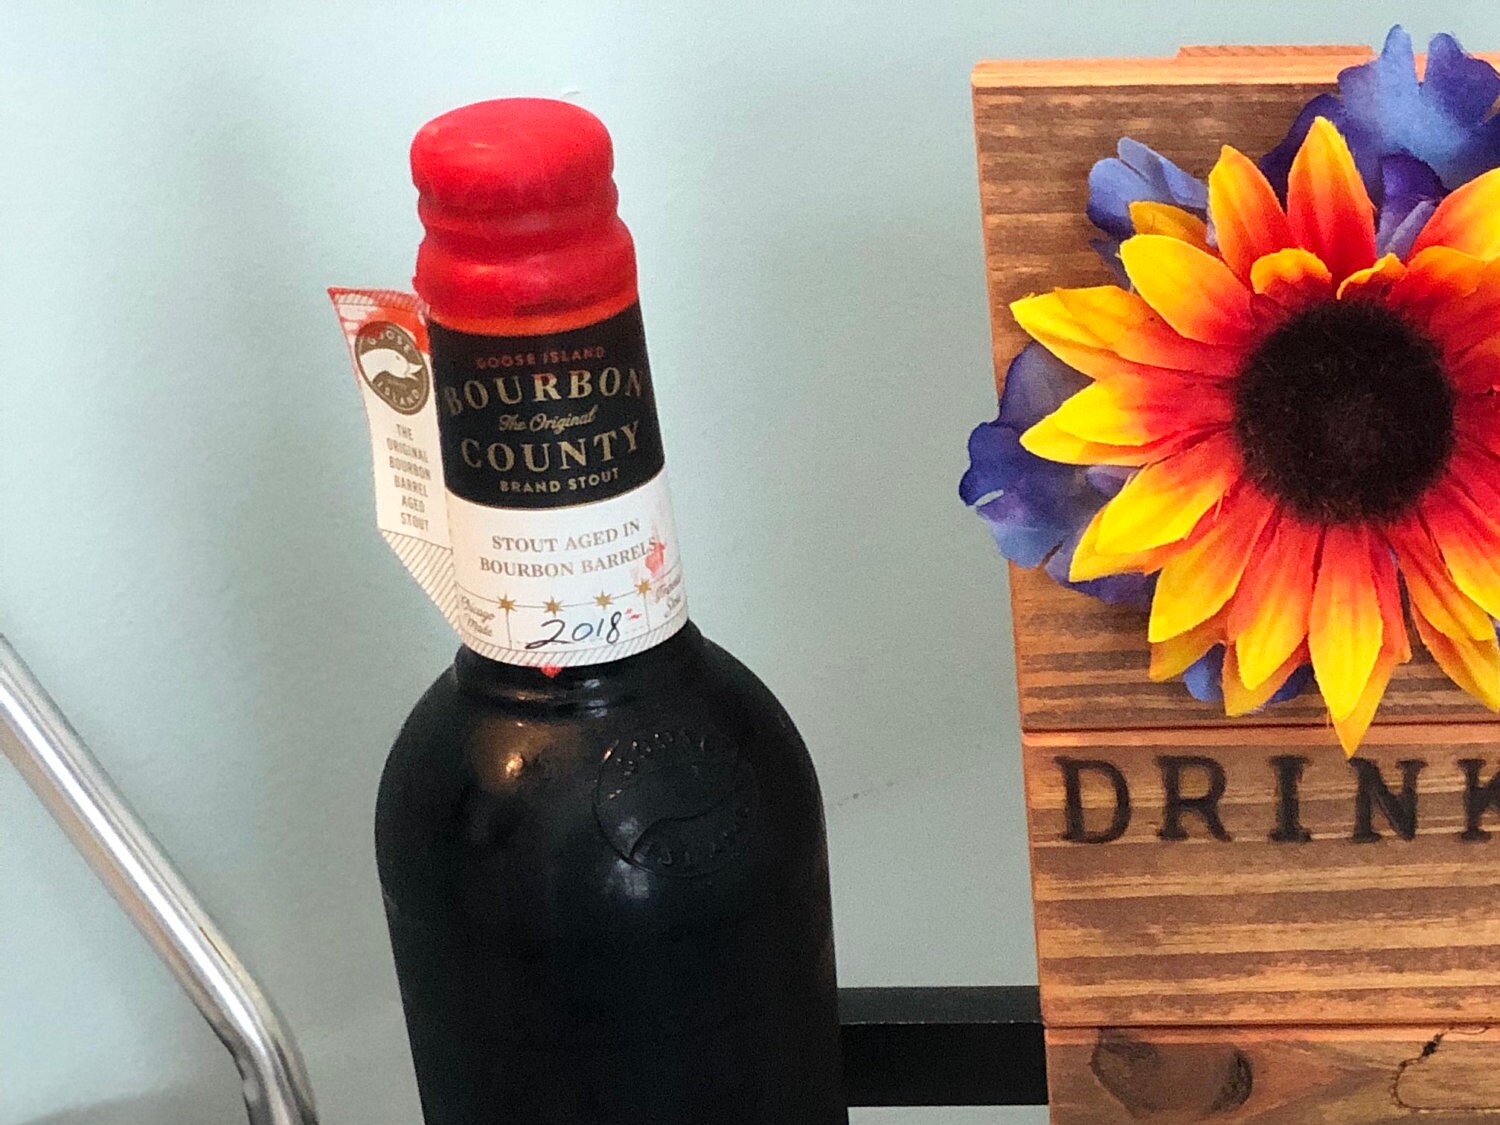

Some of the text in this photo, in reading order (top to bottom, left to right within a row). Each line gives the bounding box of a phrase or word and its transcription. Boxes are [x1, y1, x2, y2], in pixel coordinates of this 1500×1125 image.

[475, 346, 606, 370] GOOSE ISLAND
[376, 381, 421, 407] ISLAND
[444, 366, 644, 417] BOURBON
[499, 403, 600, 435] The Original
[460, 420, 640, 473] COUNTY
[388, 455, 432, 481] BOURBON
[500, 467, 620, 494] BRAND STOUT
[394, 475, 429, 498] BARREL
[401, 495, 426, 513] AGED
[400, 512, 429, 531] STOUT
[492, 518, 641, 553] STOUT AGED IN
[480, 536, 657, 578] BOURBON BARRELS
[524, 611, 623, 650] 2018
